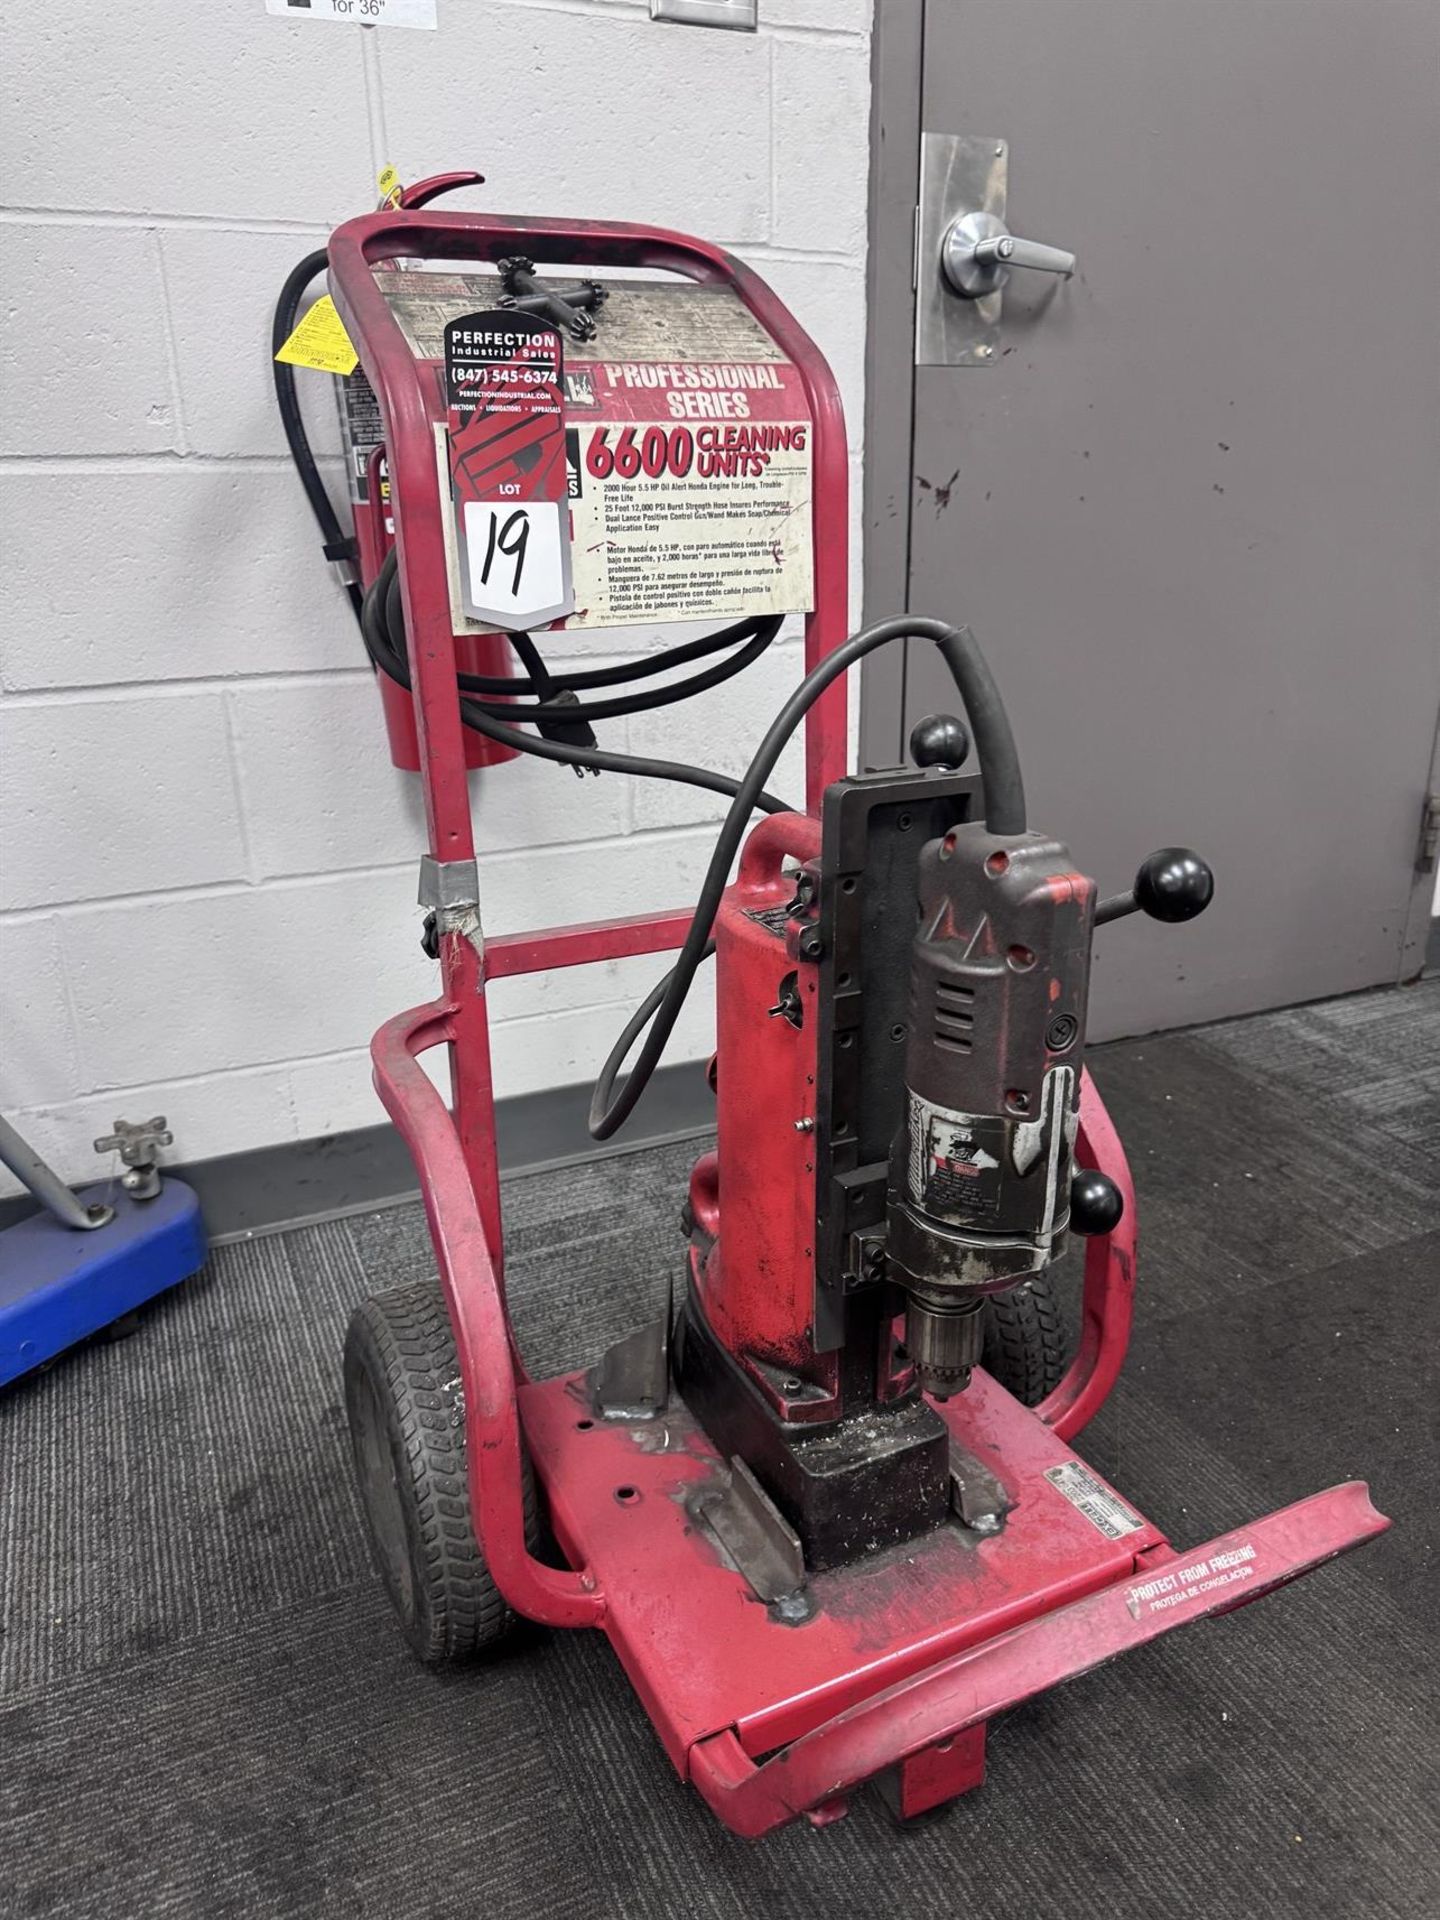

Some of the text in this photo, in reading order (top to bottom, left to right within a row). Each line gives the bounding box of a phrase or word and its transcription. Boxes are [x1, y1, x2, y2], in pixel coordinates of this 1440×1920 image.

[332, 0, 385, 16] for 36"
[452, 331, 555, 347] PERFECTION
[452, 346, 556, 359] Industrial Sales
[452, 368, 557, 384] (847) 545-6374
[604, 364, 785, 389] PROFESSIONAL
[459, 391, 551, 400] PERFECTIONINDUSTRIAL.COM
[666, 391, 750, 418] SERIES
[586, 425, 694, 479] 6600
[696, 426, 806, 452] CLEANING
[499, 484, 521, 495] LOT
[604, 484, 619, 492] 2000
[622, 484, 636, 492] Hour
[639, 484, 649, 492] 5.5
[661, 483, 669, 491] Oil
[672, 483, 686, 491] Alert
[709, 482, 729, 491] Engine
[742, 481, 758, 490] Long,
[760, 481, 784, 489] Trouble-
[604, 494, 634, 502] Free Life
[615, 504, 629, 512] Foot
[632, 504, 653, 512] 12,000
[655, 503, 666, 511] PSI
[667, 503, 684, 511] Burst
[686, 502, 712, 510] Strength
[730, 501, 752, 509] Insures
[753, 500, 790, 508] Performance
[605, 514, 620, 522] Dual
[643, 513, 668, 521] Positive
[606, 524, 659, 533] Application Easy
[481, 509, 530, 597] 19
[607, 546, 626, 554] Motor
[627, 545, 647, 553] Honda
[659, 544, 669, 552] 5.5
[696, 543, 709, 551] paro
[711, 541, 744, 550] automático
[607, 557, 621, 565] bajo
[634, 555, 655, 563] aceite,
[657, 555, 661, 563] y
[662, 554, 680, 562] 2,000
[704, 552, 718, 560] para
[731, 550, 747, 558] larga
[748, 549, 761, 557] vida
[608, 566, 644, 575] problemas.
[608, 575, 640, 583] Manguera
[652, 573, 665, 581] 7.62
[699, 571, 714, 579] largo
[721, 569, 743, 578] presión
[753, 568, 774, 576] ruptura
[609, 584, 631, 593] 12,000
[645, 584, 659, 592] para
[660, 583, 687, 591] asegurar
[689, 581, 725, 589] desempeño.
[609, 595, 631, 603] Pistola
[643, 592, 665, 600] control
[667, 591, 690, 600] positivo
[705, 588, 721, 596] doble
[742, 585, 763, 594] facilita
[610, 603, 642, 612] aplicación
[654, 601, 678, 609] jabones
[1131, 1545, 1257, 1600] PROTECT FROM FREEZING
[1150, 1591, 1189, 1611] PROTEGA
[1187, 1586, 1200, 1597] DE
